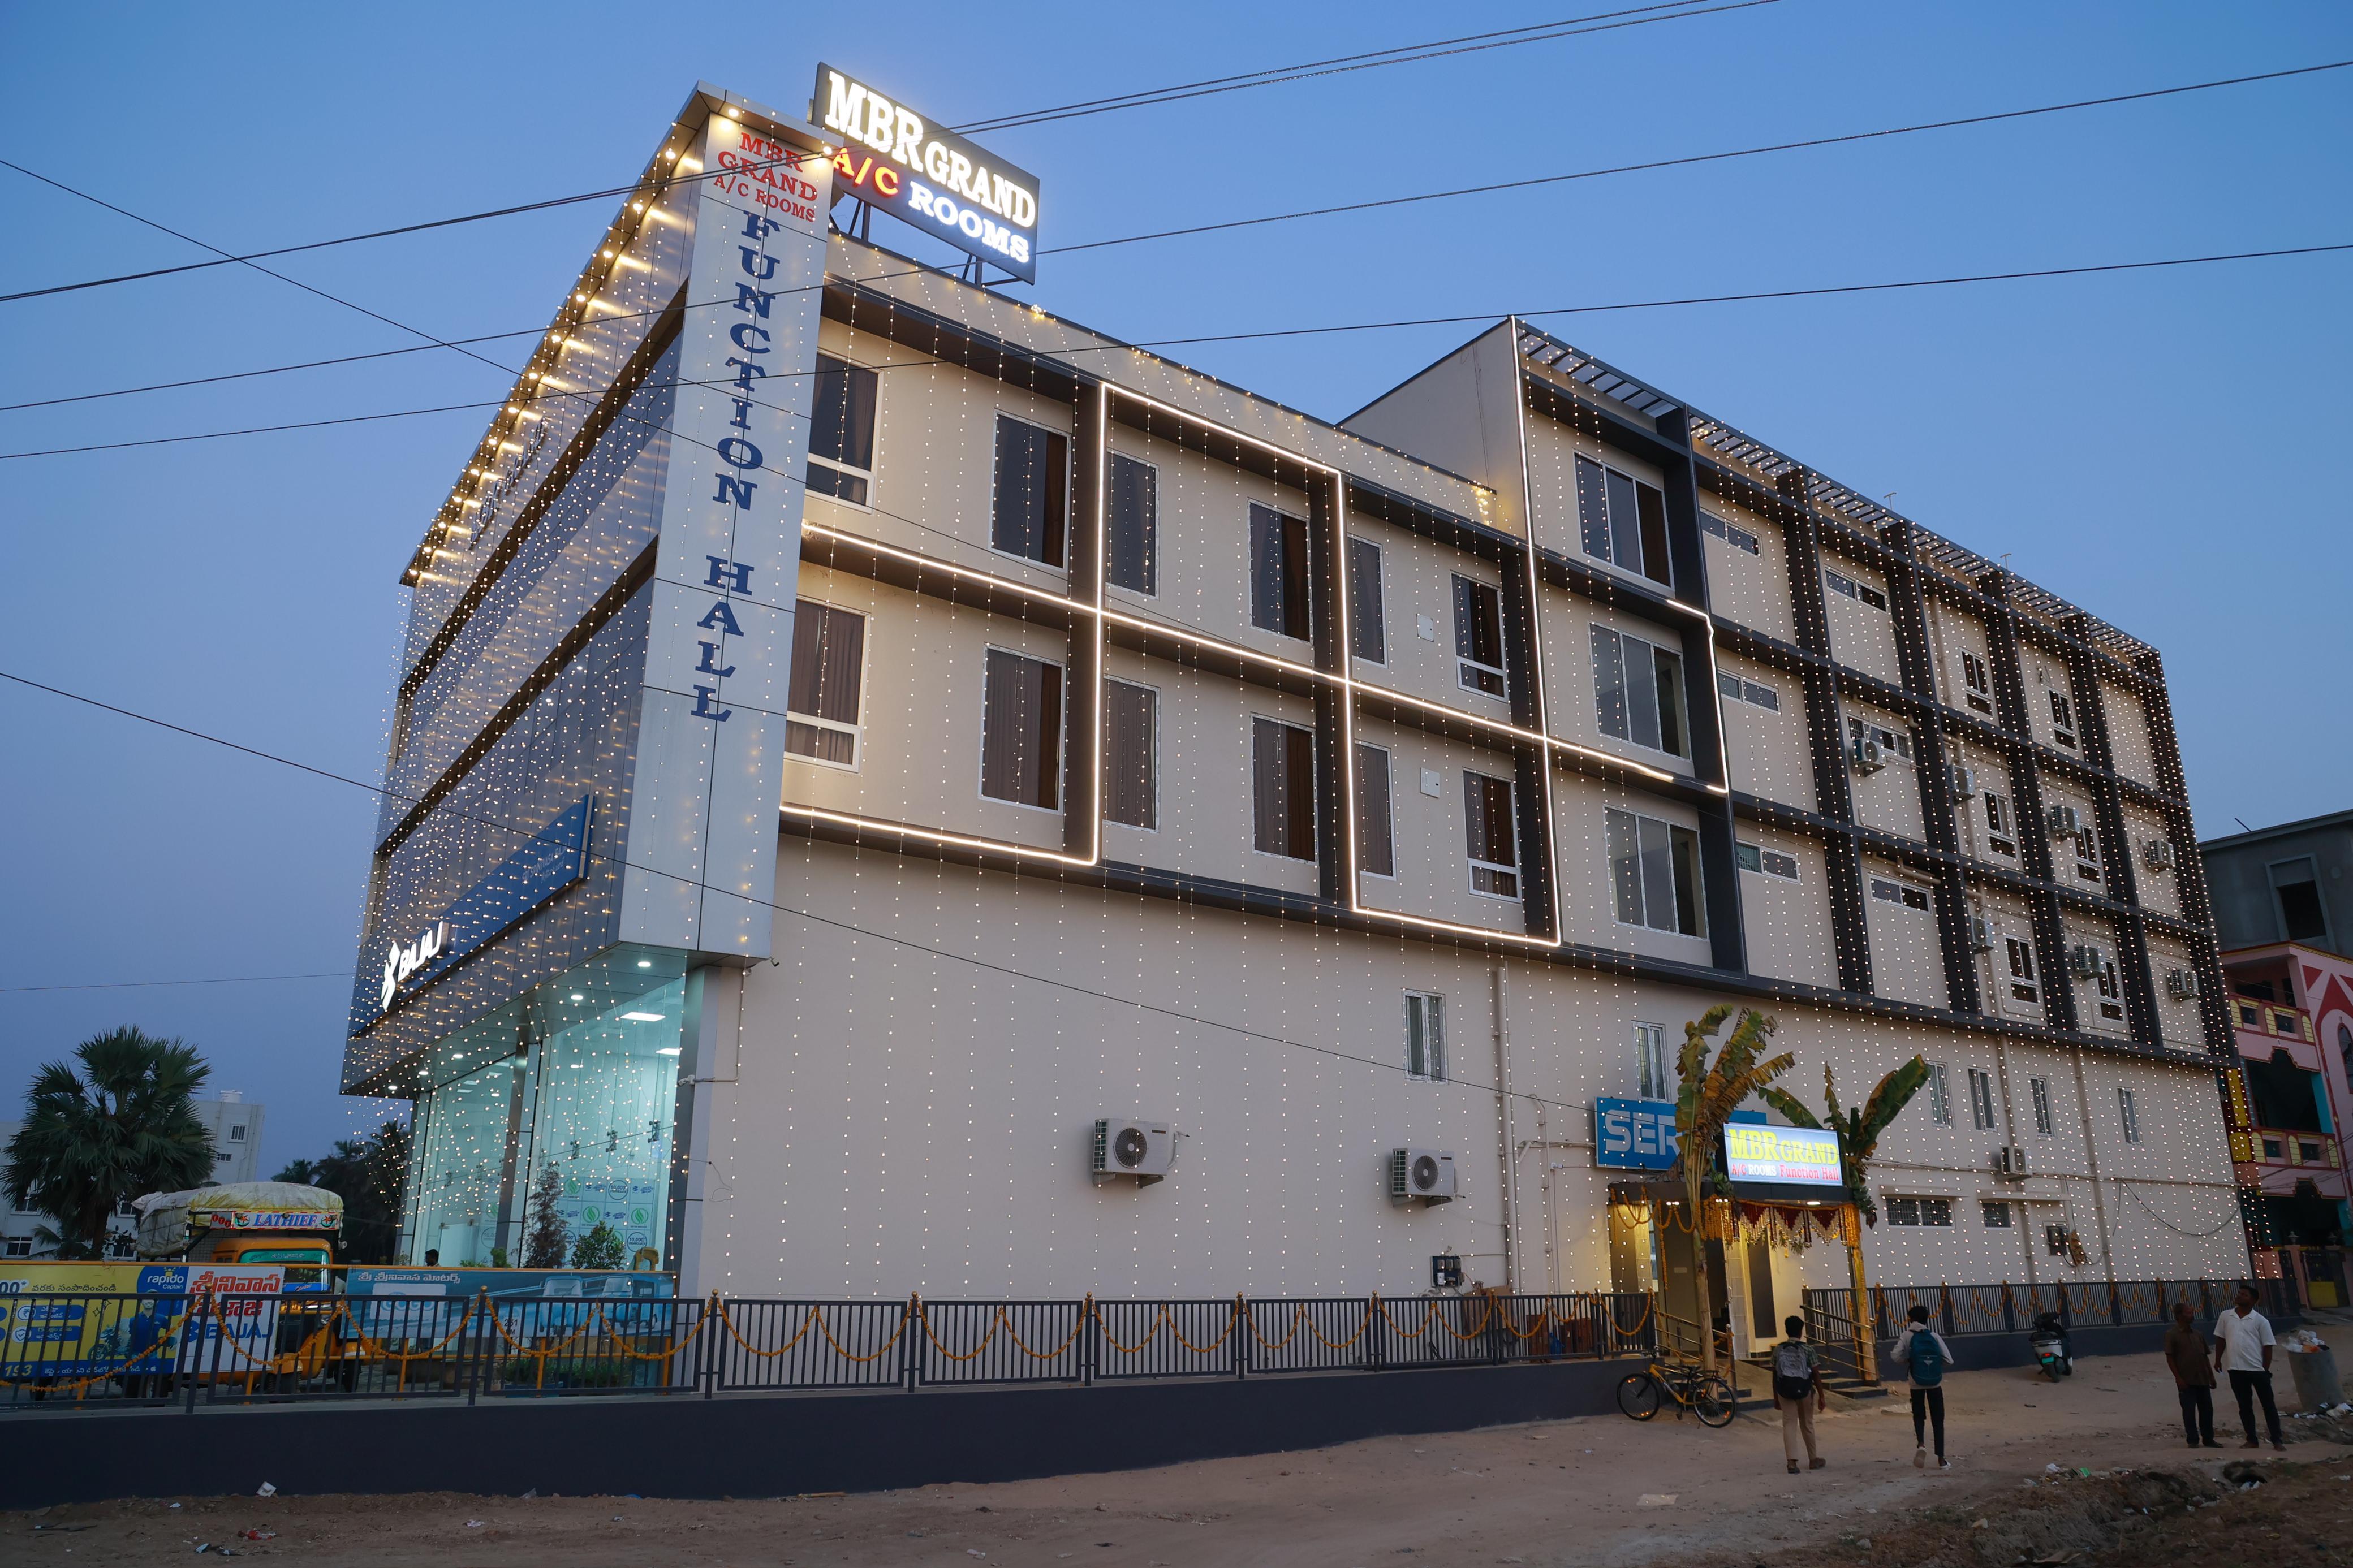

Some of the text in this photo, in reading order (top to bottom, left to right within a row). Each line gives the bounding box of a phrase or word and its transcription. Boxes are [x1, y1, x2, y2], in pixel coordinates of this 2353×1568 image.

[740, 132, 803, 172] MBR
[825, 71, 1036, 227] MBR GRAND
[713, 175, 815, 222] A/C ROOMS
[717, 151, 818, 201] GRAND
[833, 146, 1029, 263] A/C ROOMS
[691, 210, 780, 722] FUNCTION HALL
[398, 921, 443, 982] BAJAJ
[1729, 1129, 1838, 1165] MBR GRAND
[1731, 1163, 1839, 1180] A/C ROOMS Function Hall
[253, 1213, 318, 1227] LATHIEF
[146, 1273, 184, 1285] rapido
